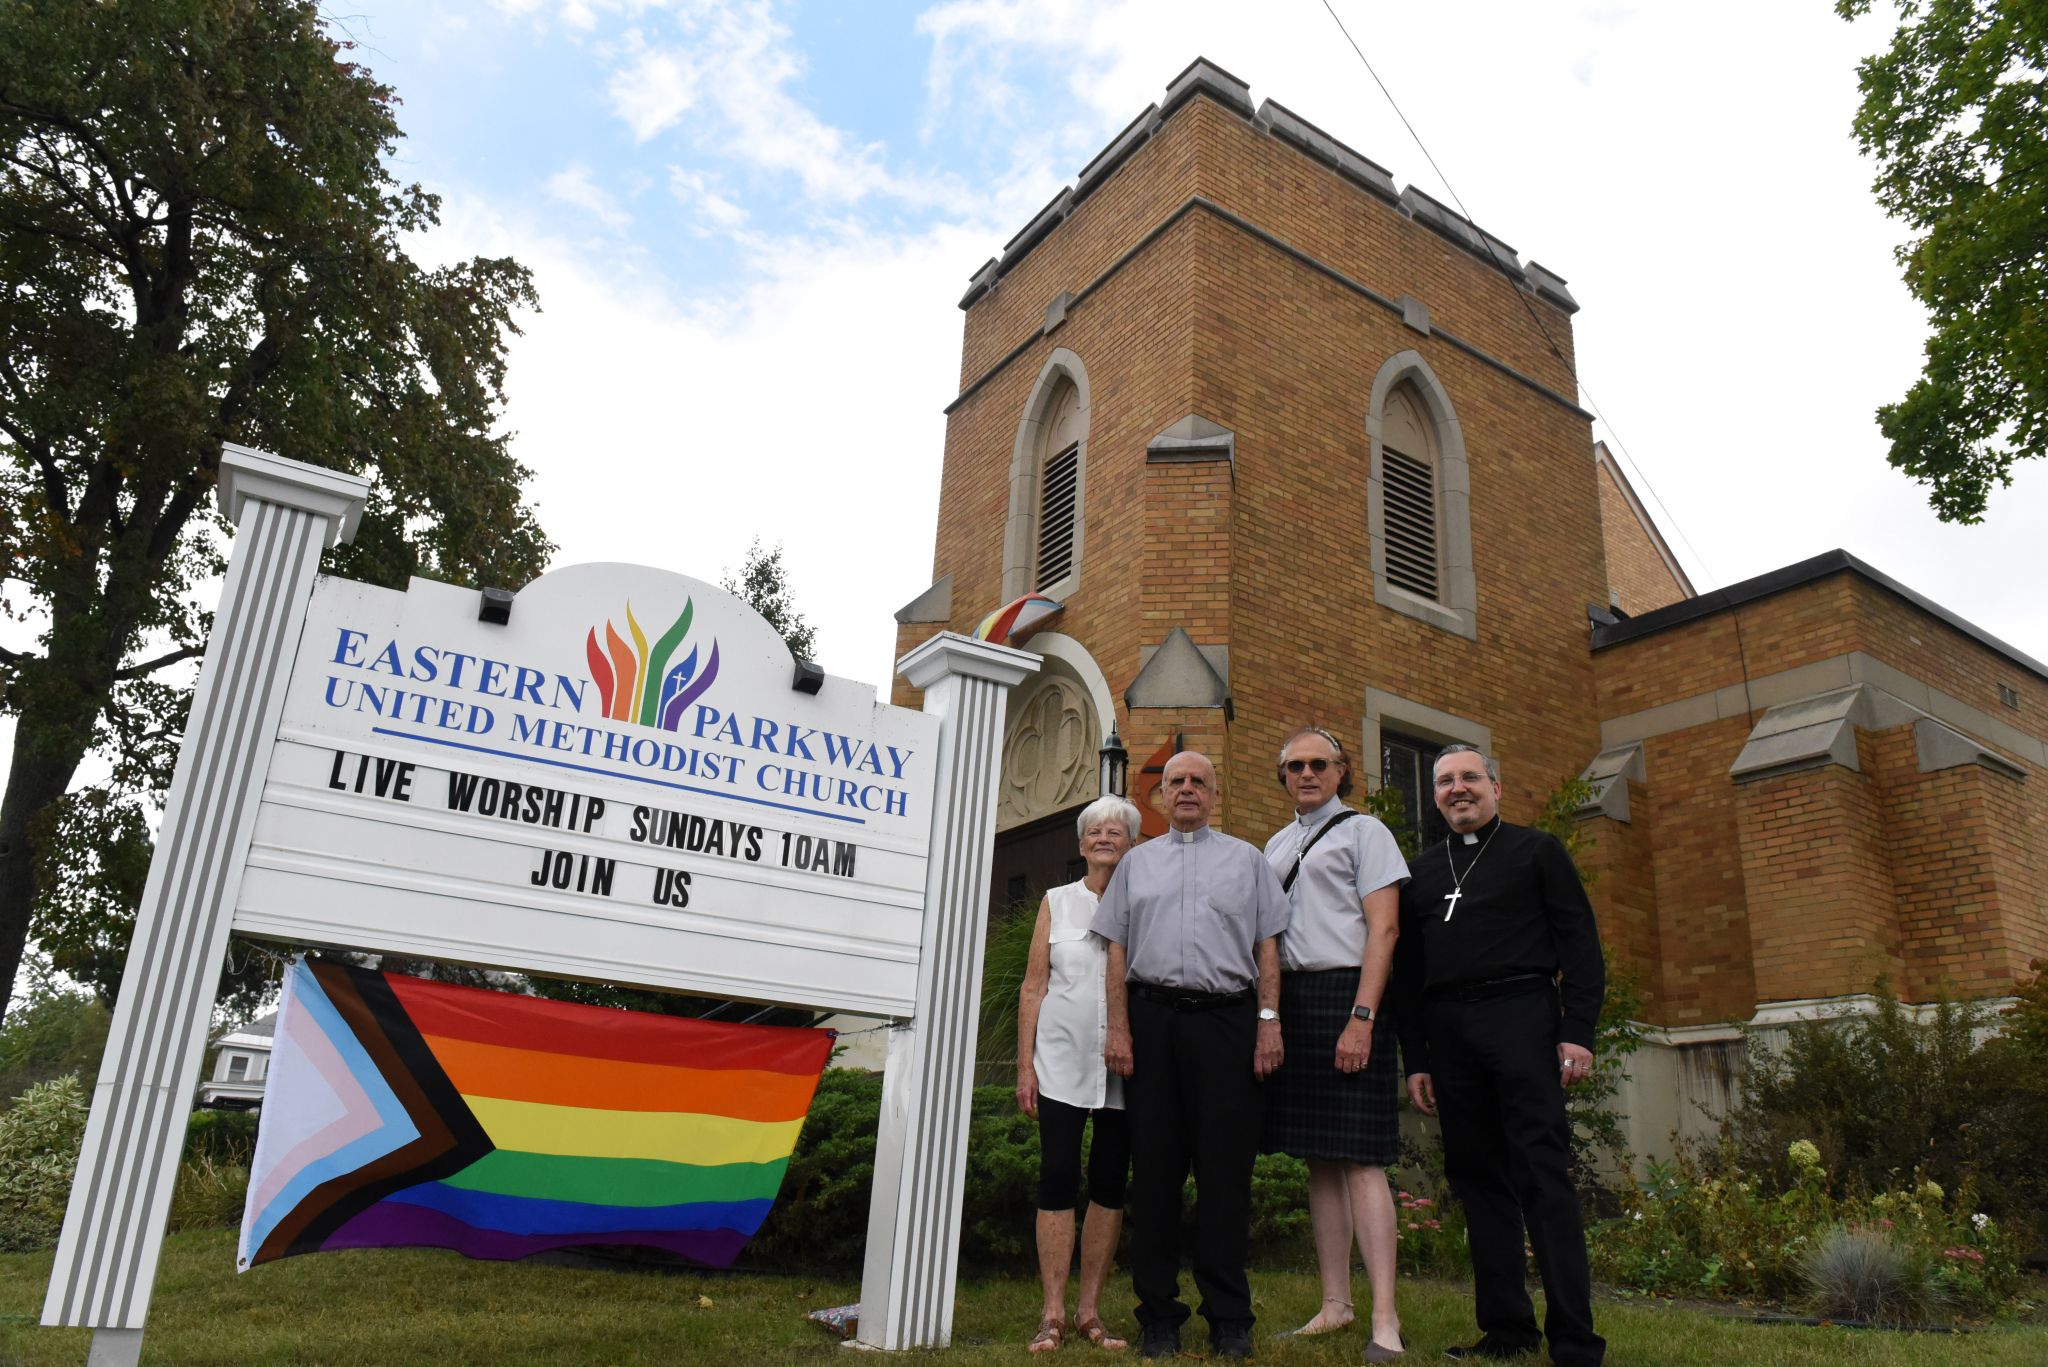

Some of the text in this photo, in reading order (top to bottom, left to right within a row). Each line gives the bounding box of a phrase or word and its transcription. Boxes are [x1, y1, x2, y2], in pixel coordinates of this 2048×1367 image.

[325, 676, 910, 817] UNITED METHODIST CHURCH
[329, 627, 914, 780] EASTERN PARKWAY
[329, 750, 856, 877] LIVE WORSHIP SUNDAYS 10AM
[531, 850, 691, 908] JOIN US
